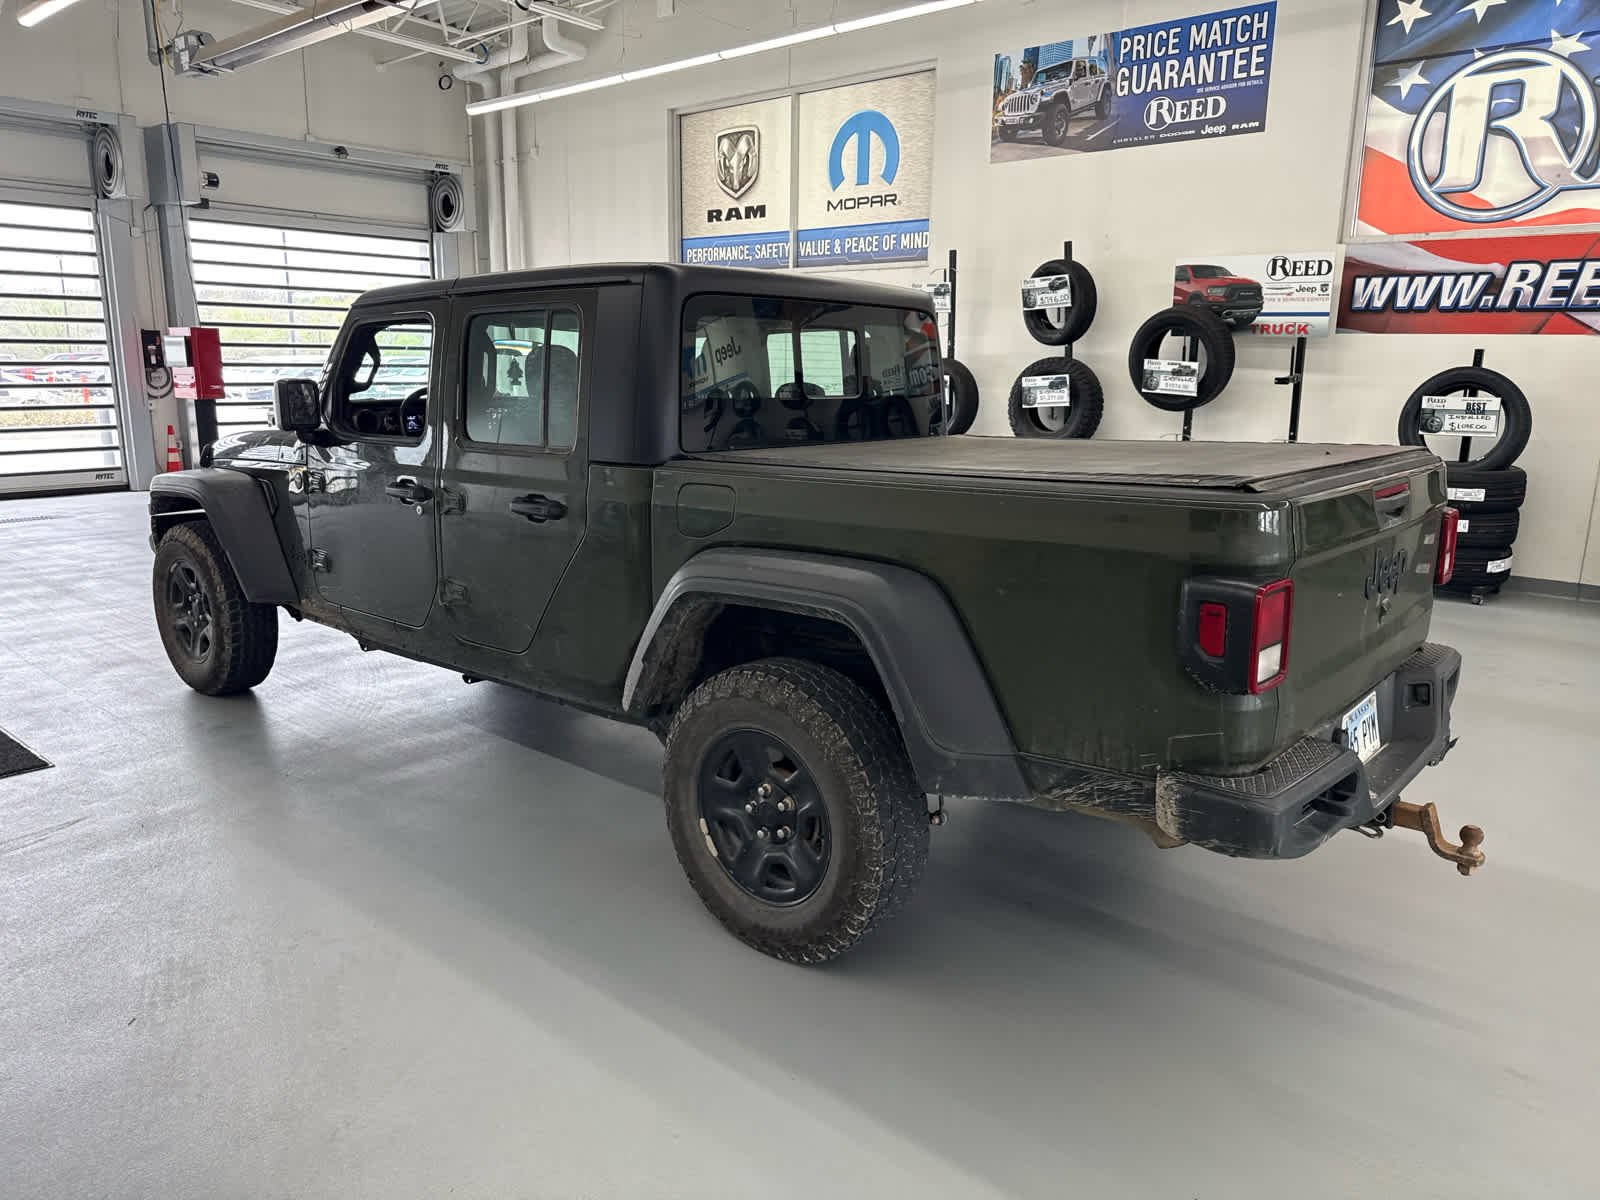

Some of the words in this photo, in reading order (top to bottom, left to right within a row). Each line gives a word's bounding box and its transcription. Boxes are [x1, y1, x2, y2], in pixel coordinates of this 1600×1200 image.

[1119, 27, 1182, 63] PRICE
[1189, 10, 1269, 52] MATCH
[1115, 44, 1268, 97] GUARANTEE
[75, 110, 99, 120] RYTEC
[1144, 96, 1227, 131] REED
[1159, 129, 1196, 138] DODGE
[1200, 123, 1227, 136] Jeep
[1231, 120, 1260, 130] RAM
[826, 193, 898, 213] MOPAR
[707, 204, 767, 223] RAM
[686, 244, 753, 265] PERFORMANCE,
[754, 242, 791, 259] SAFETY
[799, 239, 831, 257] VALUE
[834, 239, 842, 255] &
[844, 236, 880, 254] PEACE
[882, 234, 898, 250] OF
[900, 231, 930, 250] MIND
[1266, 256, 1333, 281] REED
[1295, 284, 1318, 294] Jeep
[1251, 322, 1310, 336] TRUCK
[1466, 402, 1487, 411] BEST
[95, 472, 115, 481] RYTEC
